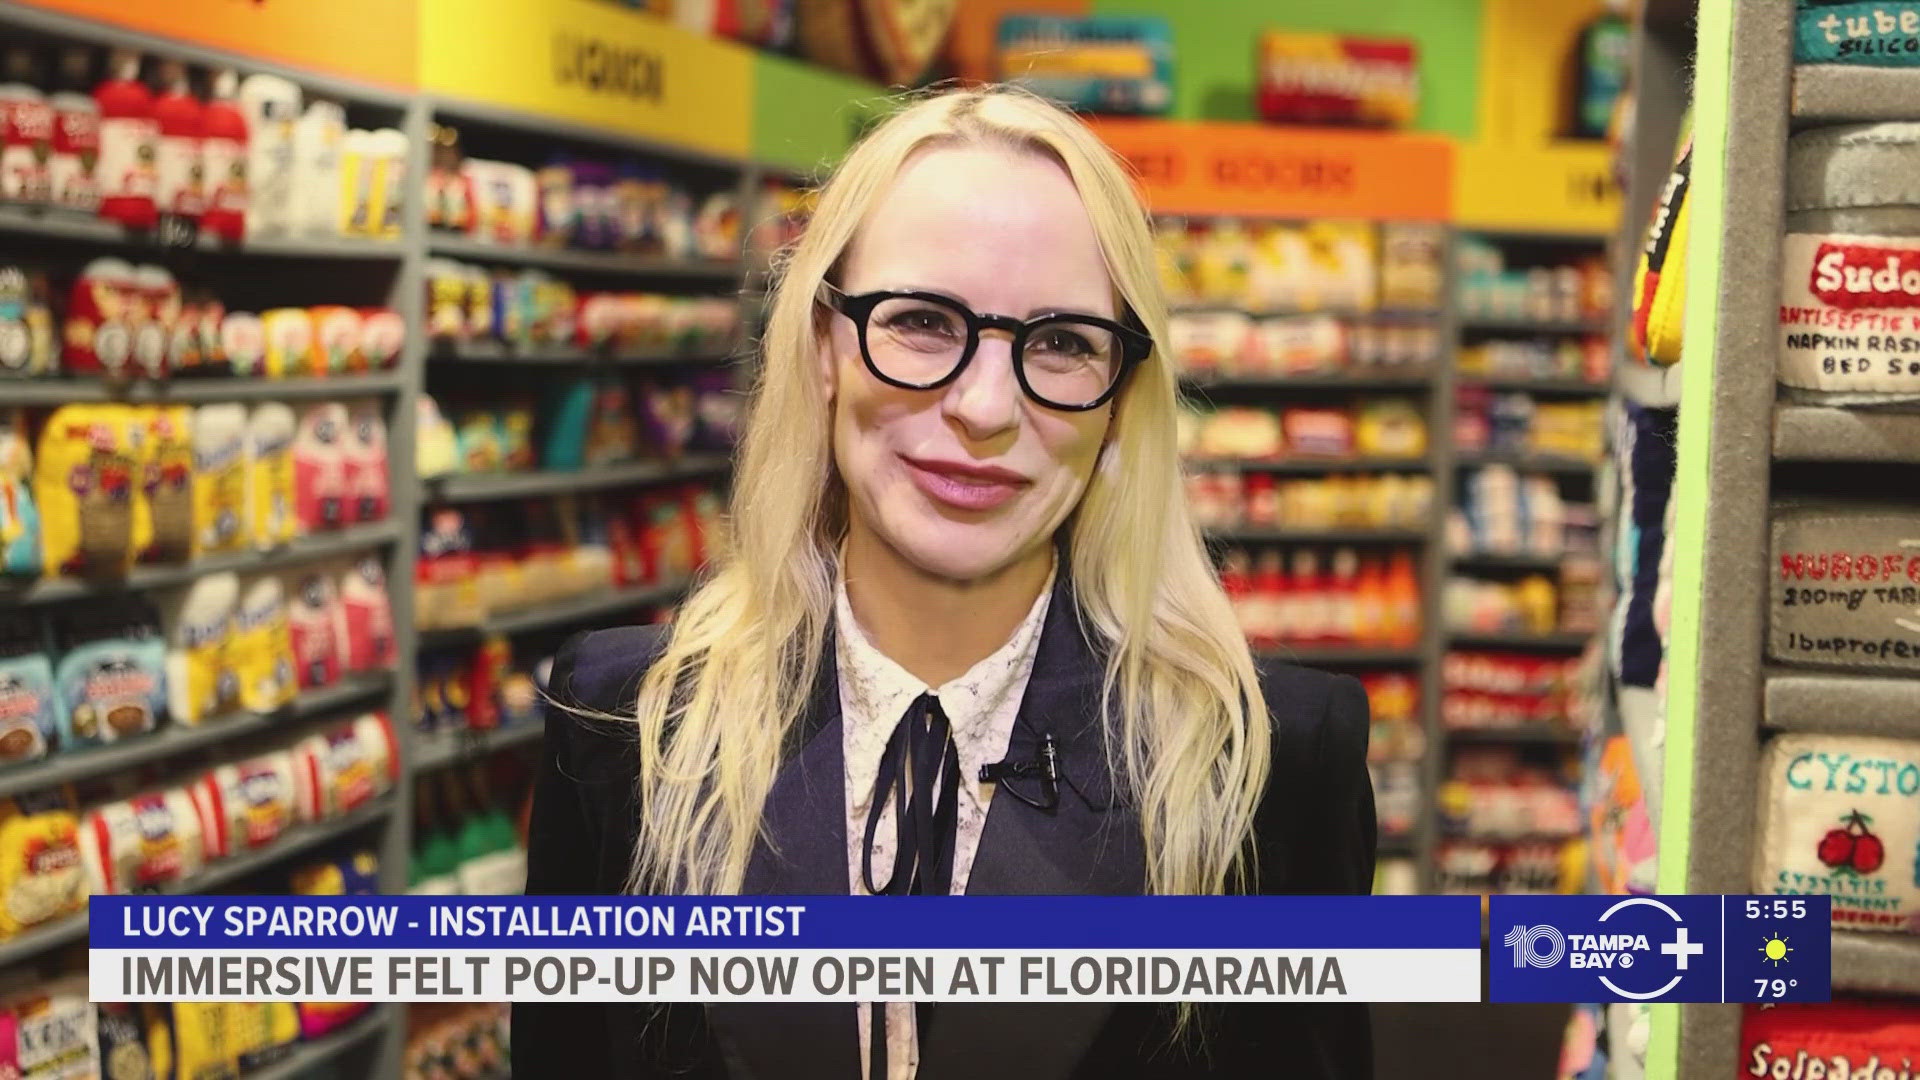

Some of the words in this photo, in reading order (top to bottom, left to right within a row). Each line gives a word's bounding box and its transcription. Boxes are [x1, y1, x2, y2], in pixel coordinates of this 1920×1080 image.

[1787, 333, 1859, 350] NAPKIN
[1783, 587, 1867, 610] 200mg
[1874, 586, 1920, 605] TAB
